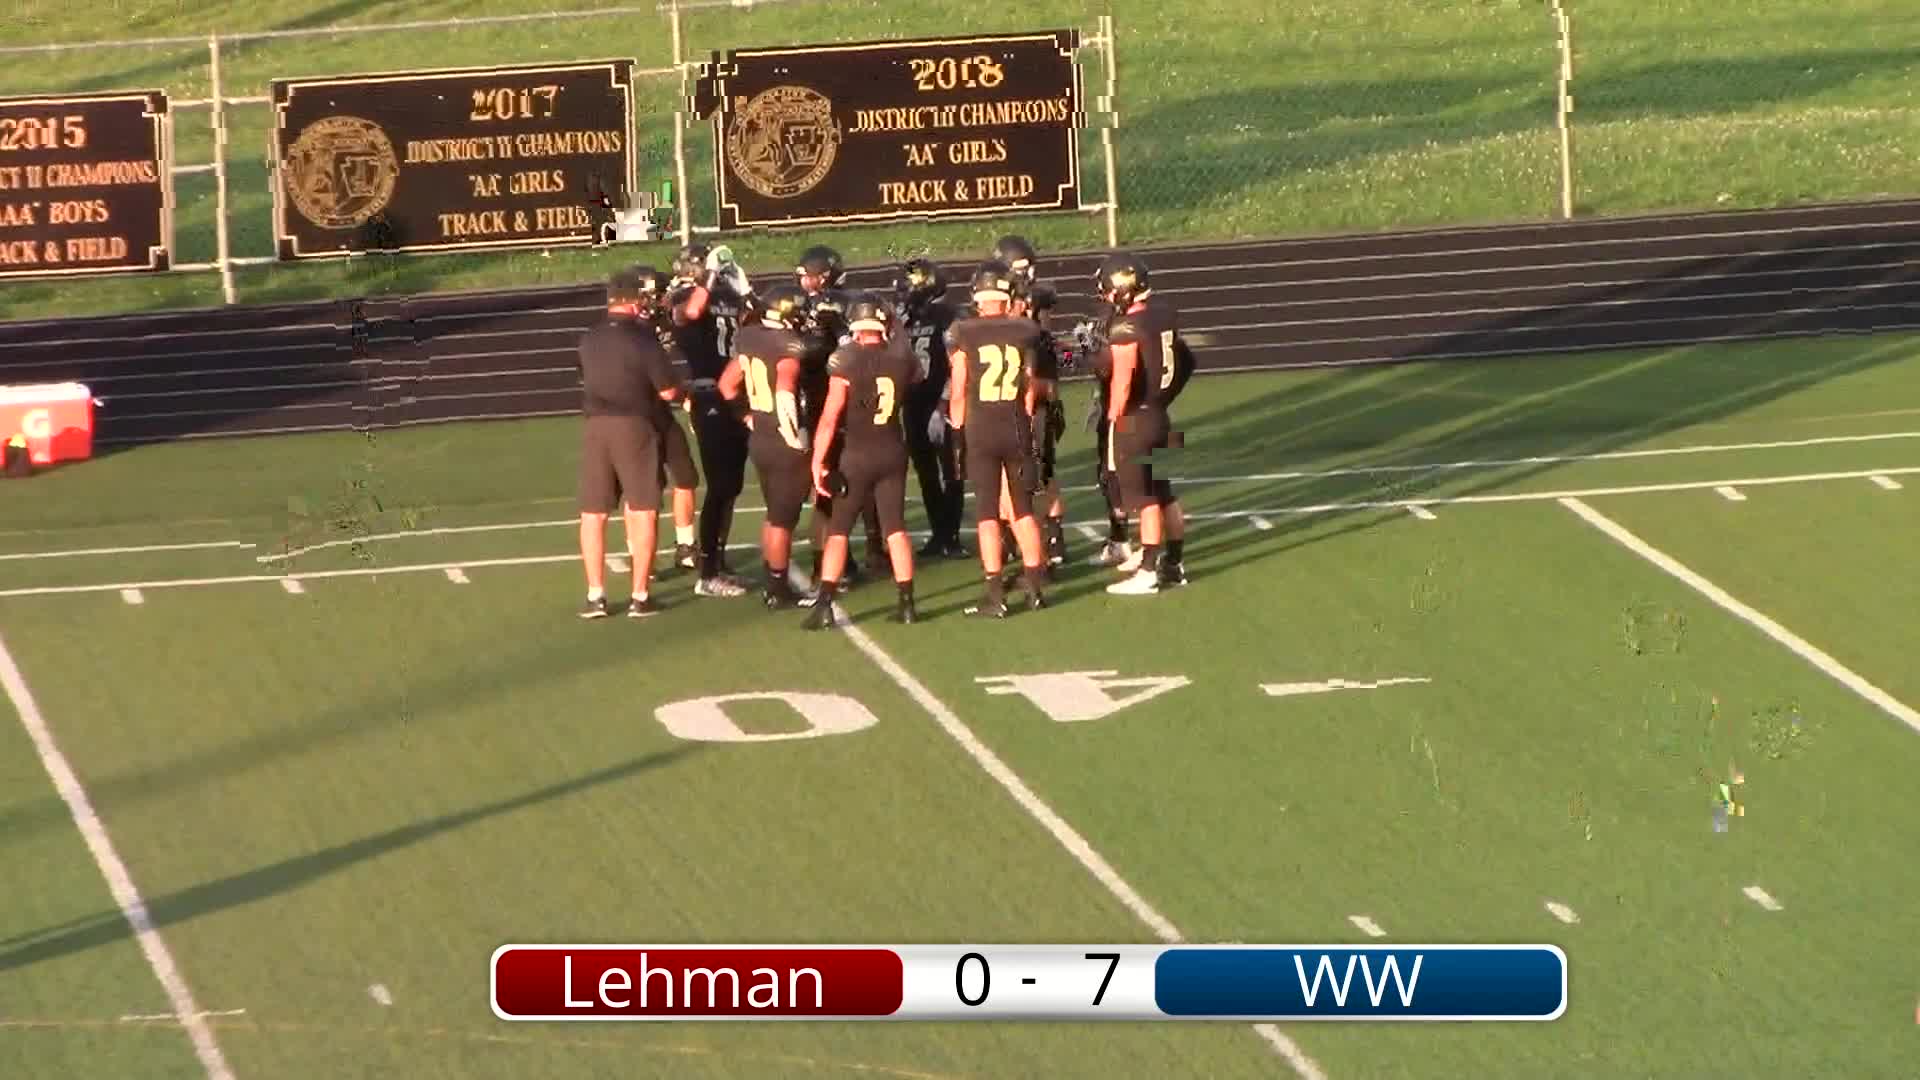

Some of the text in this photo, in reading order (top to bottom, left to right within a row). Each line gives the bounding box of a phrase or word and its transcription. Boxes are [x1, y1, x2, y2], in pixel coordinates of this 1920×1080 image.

[909, 55, 1004, 91] 2018
[470, 85, 558, 121] 2017
[960, 99, 1069, 127] CHAMPIONS
[0, 115, 86, 149] 2015
[949, 138, 1007, 165] GIRLS
[47, 161, 158, 187] CHAMPIONS
[510, 170, 565, 194] GIRLS
[878, 175, 1034, 205] TRACK & FIELD
[49, 200, 110, 224] BOYS
[438, 206, 593, 236] TRACK & FIELD
[44, 241, 61, 263] &
[67, 236, 128, 261] FIELD
[977, 344, 1021, 402] 22
[1160, 330, 1175, 390] 5
[873, 376, 895, 425] 3
[22, 407, 50, 438] G
